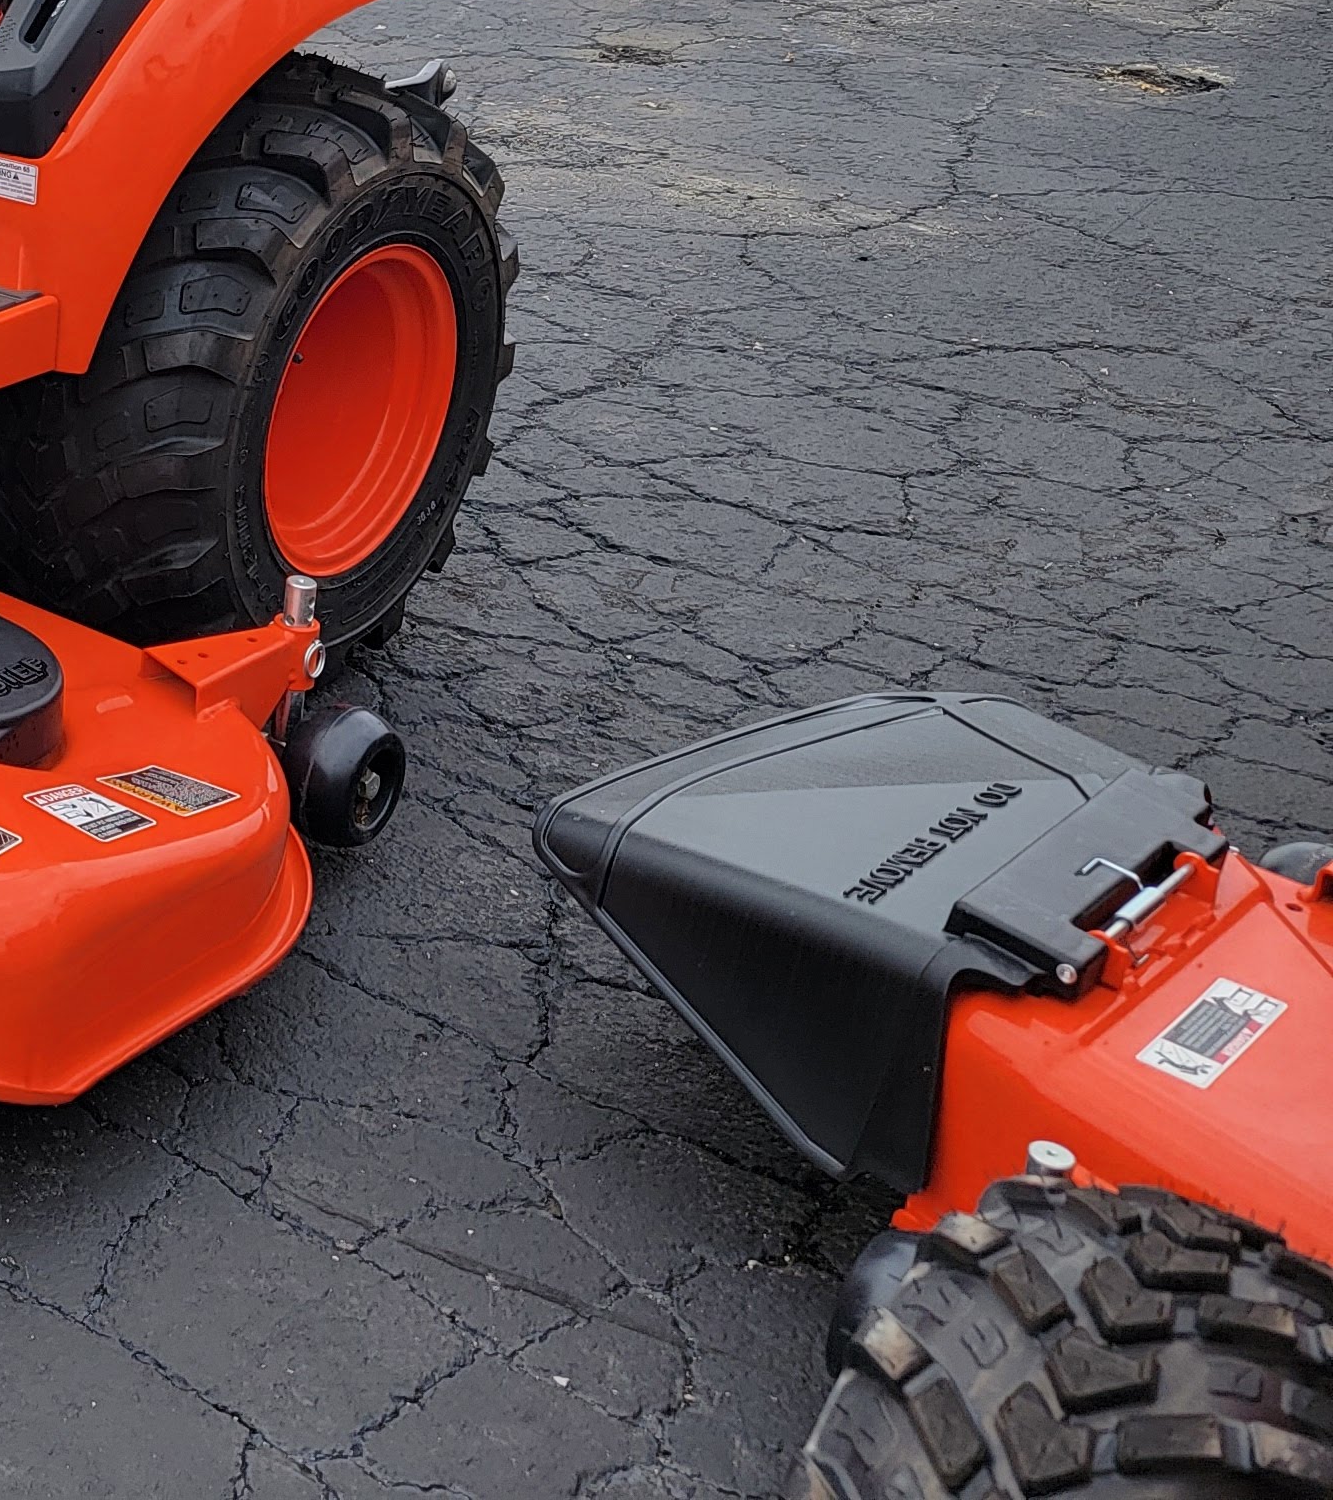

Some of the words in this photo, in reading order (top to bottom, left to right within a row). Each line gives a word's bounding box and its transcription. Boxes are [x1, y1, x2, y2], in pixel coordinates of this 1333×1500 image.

[44, 786, 88, 803] DANGER
[972, 782, 1023, 808] DO
[928, 806, 989, 843] NOT
[842, 837, 947, 905] REMOVE
